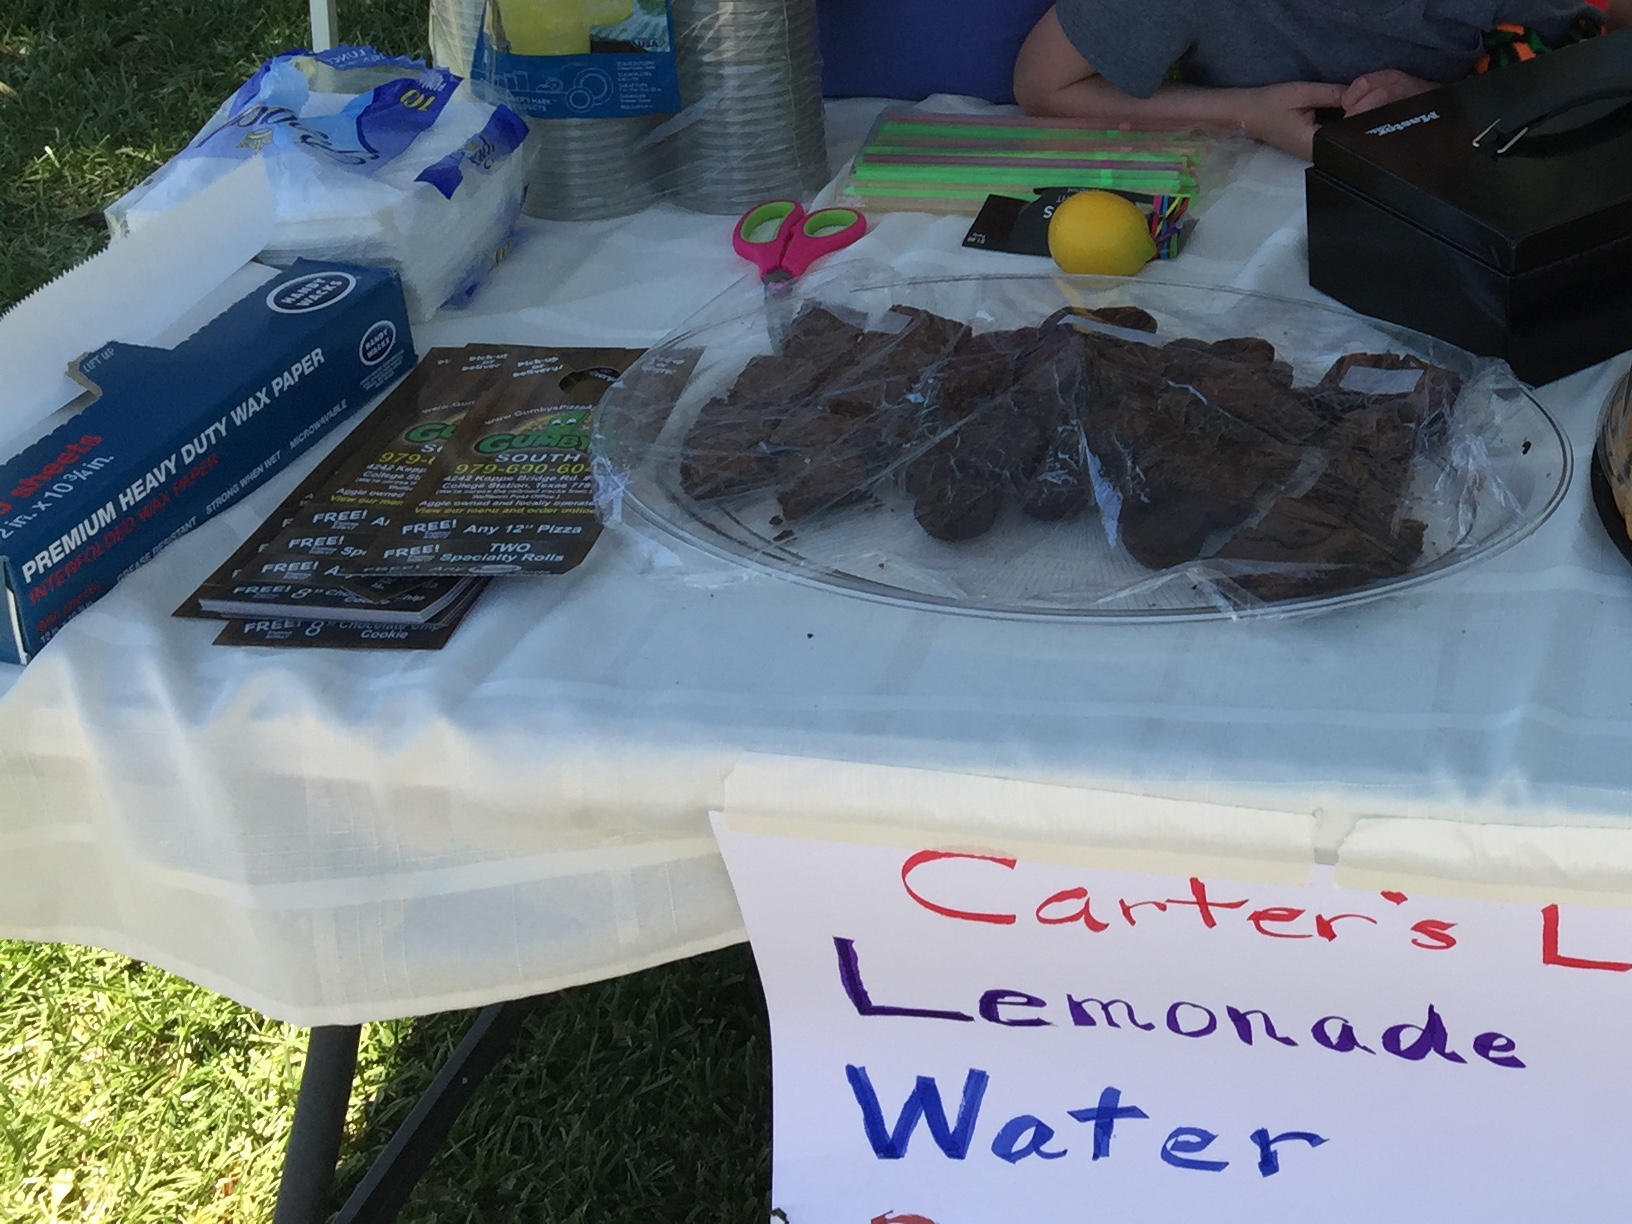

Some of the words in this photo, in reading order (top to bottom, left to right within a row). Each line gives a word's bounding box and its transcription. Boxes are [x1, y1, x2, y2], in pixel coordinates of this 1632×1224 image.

[83, 354, 101, 373] LIFT
[100, 347, 116, 363] UP
[21, 499, 117, 583] PREMIUM
[118, 451, 178, 514] HEAVY
[180, 416, 229, 467] DUTY
[229, 389, 272, 427] WAX
[270, 347, 325, 398] PAPER
[205, 483, 240, 515] STRONG
[239, 465, 265, 493] WHEN
[263, 449, 283, 471] WET
[288, 398, 348, 450] MICROWAVABLE
[495, 453, 582, 463] SOUTH
[137, 491, 171, 523] WAX
[312, 509, 368, 523] FREE!
[402, 519, 457, 535] FREE!
[463, 524, 500, 536] Any
[536, 524, 583, 534] Pizza
[288, 535, 345, 549] FREE!
[489, 542, 531, 553] TWO
[383, 544, 440, 559] FREE!
[439, 553, 518, 563] Specialty
[520, 553, 564, 562] Rolls
[261, 560, 319, 574] FREE!
[232, 585, 292, 595] FREE!
[360, 629, 409, 639] Cookie
[900, 850, 1459, 951] Carter's
[832, 936, 1528, 1070] Lemonade
[846, 1064, 1332, 1180] Water
